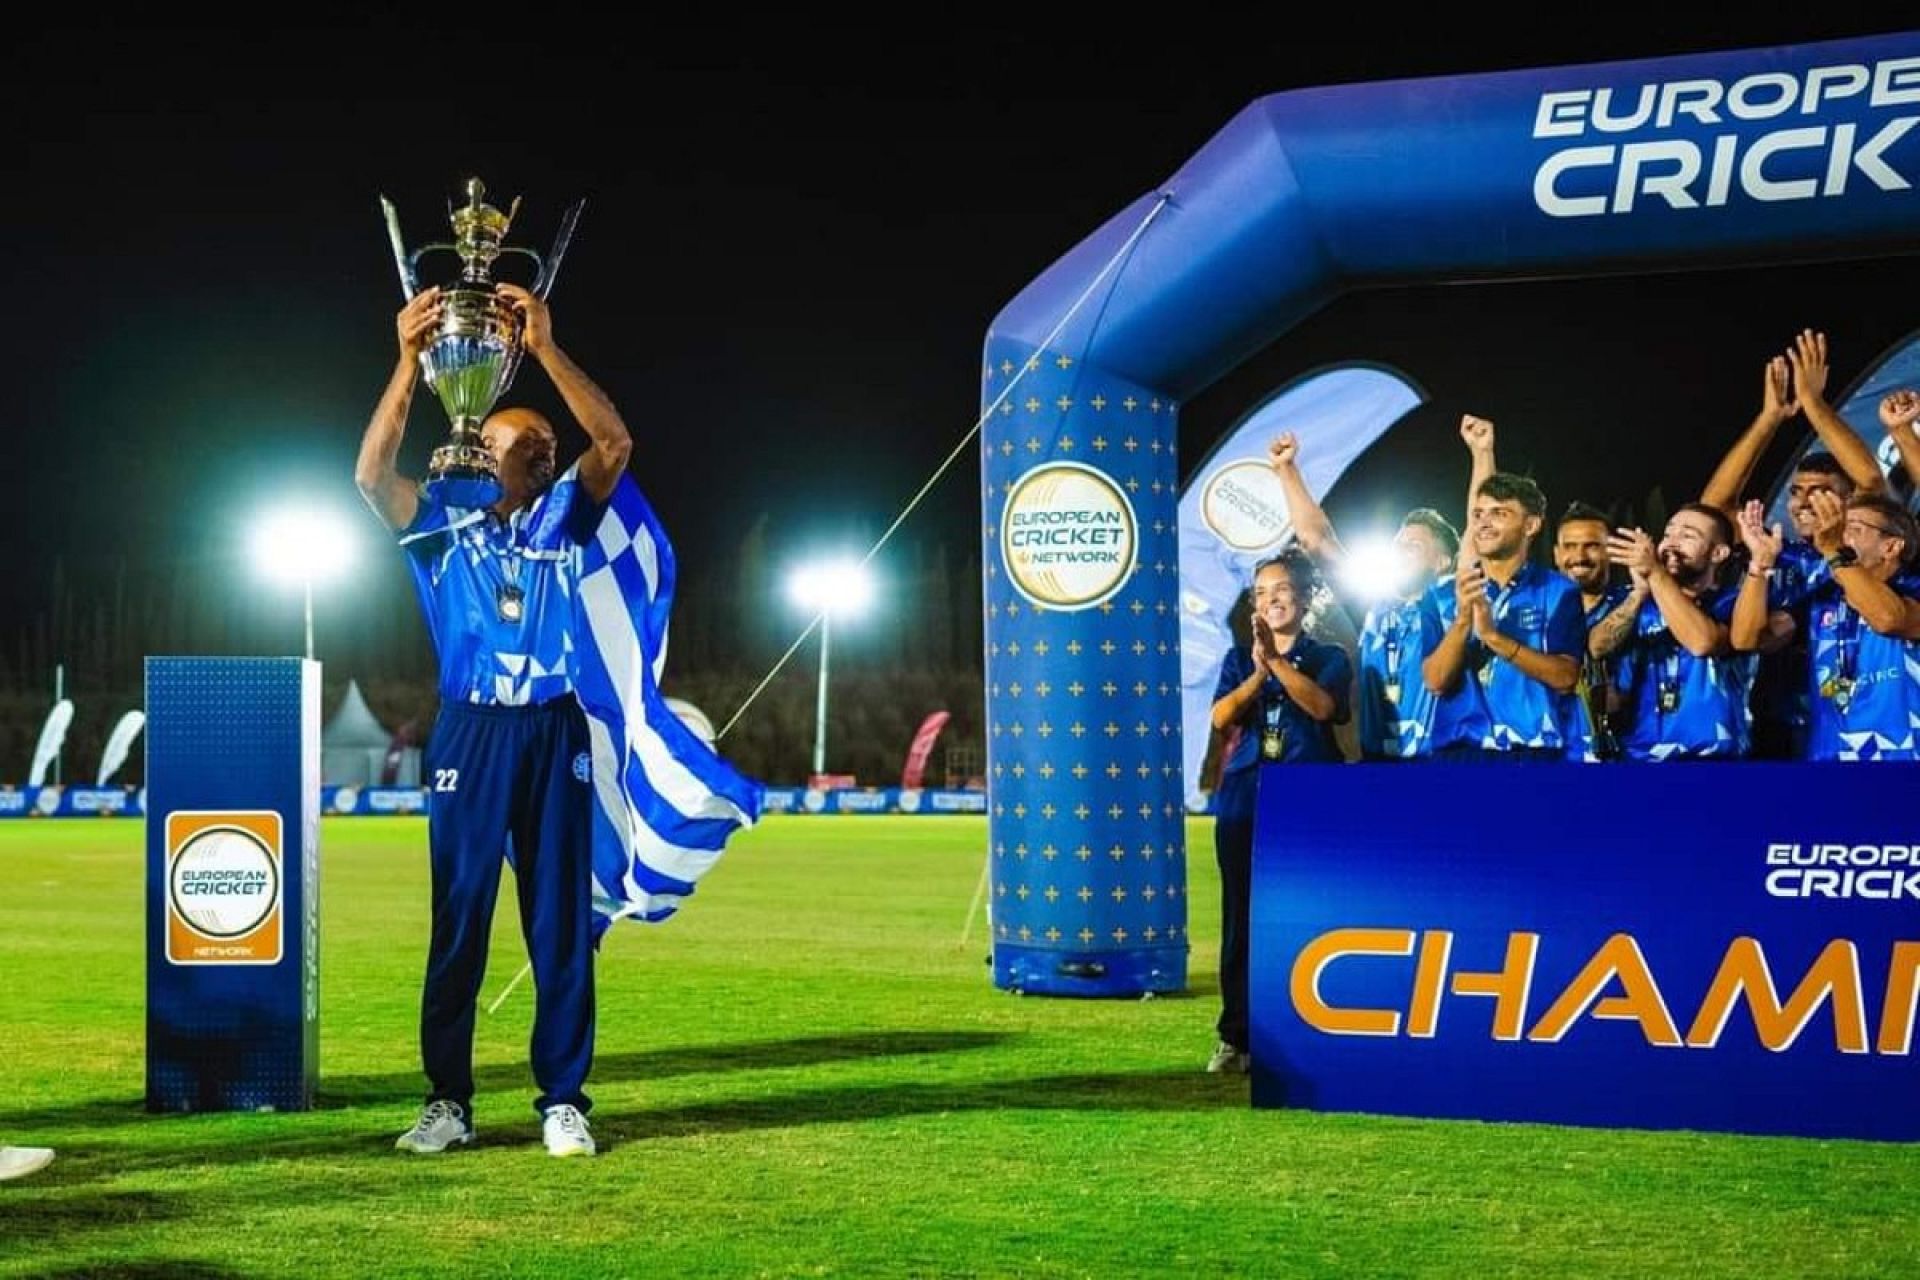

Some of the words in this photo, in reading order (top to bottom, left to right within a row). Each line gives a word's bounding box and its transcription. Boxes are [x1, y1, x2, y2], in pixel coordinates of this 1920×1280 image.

[1533, 56, 1920, 139] EUROPE
[1533, 116, 1920, 218] CRICK
[1011, 510, 1121, 526] EUROPEAN
[1010, 527, 1124, 547] CRICKET
[1031, 551, 1120, 563] NETWORK
[435, 768, 459, 793] 22
[181, 870, 266, 881] EUROPEAN
[1765, 868, 1920, 900] CRICK
[181, 881, 267, 896] CRICKET
